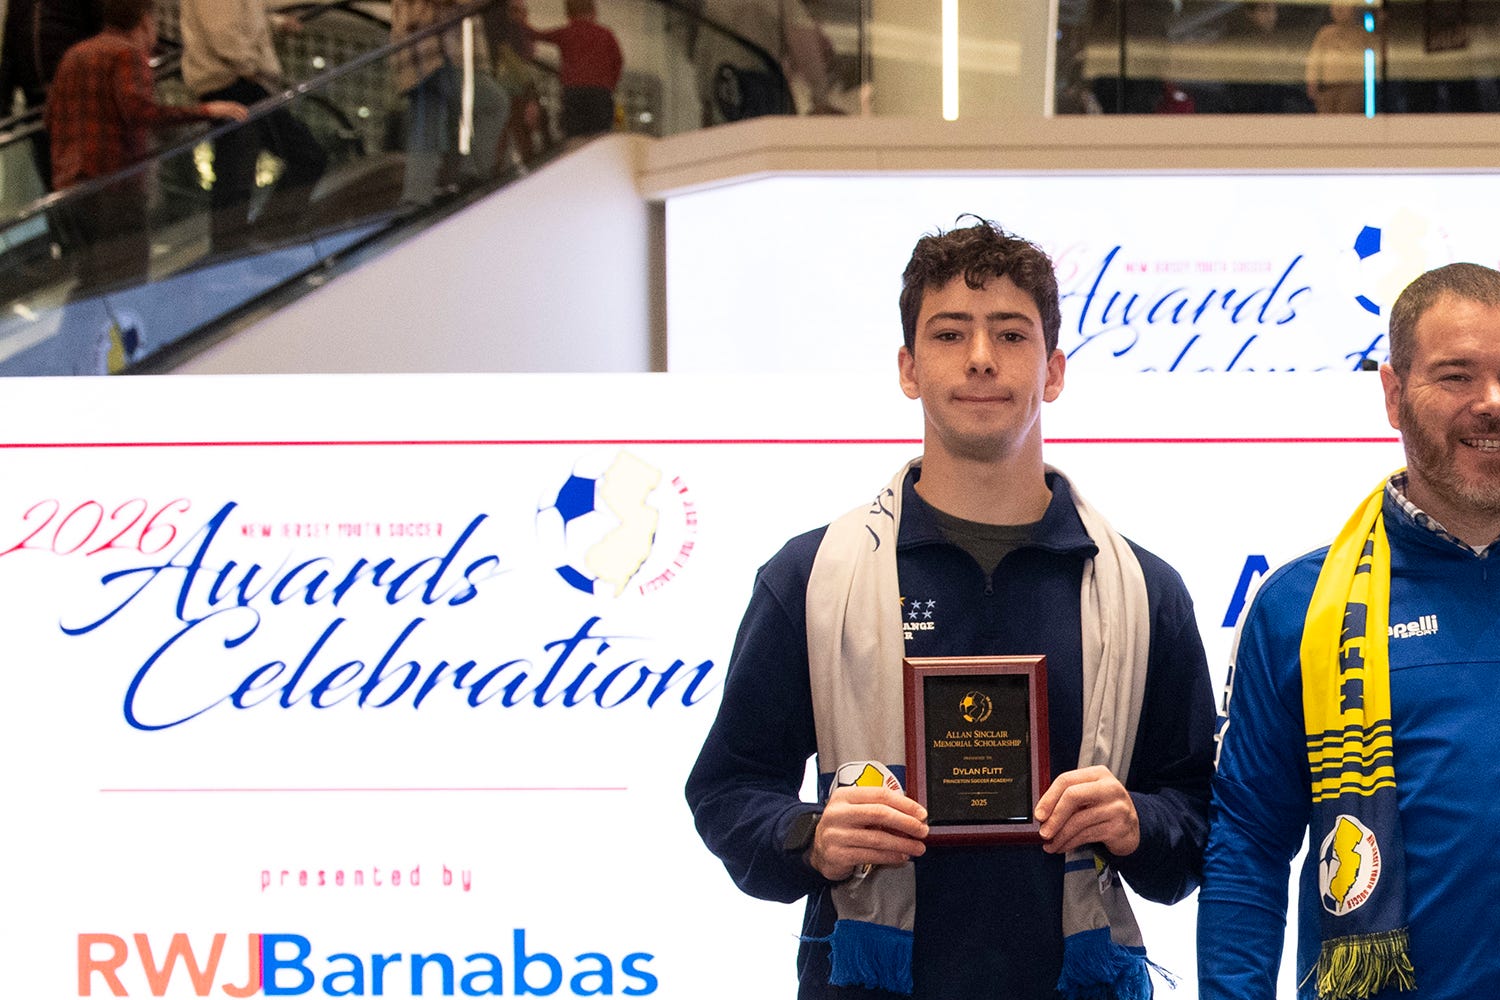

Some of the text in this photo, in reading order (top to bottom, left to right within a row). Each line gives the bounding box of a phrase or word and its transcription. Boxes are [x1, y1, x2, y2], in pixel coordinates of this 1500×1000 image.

[1061, 246, 1311, 335] Awards
[0, 498, 191, 556] 2026
[60, 501, 502, 636] Awards
[902, 622, 935, 630] ANGE
[1388, 614, 1438, 639] pelli
[122, 605, 722, 731] Celebration
[933, 739, 1021, 748] MEMORIAL SCHOLARSHIP
[945, 730, 1008, 739] ALLAN SINCLAIR
[952, 766, 1003, 775] DYLAN FLITT
[971, 799, 987, 807] 2025
[260, 864, 473, 892] presented by
